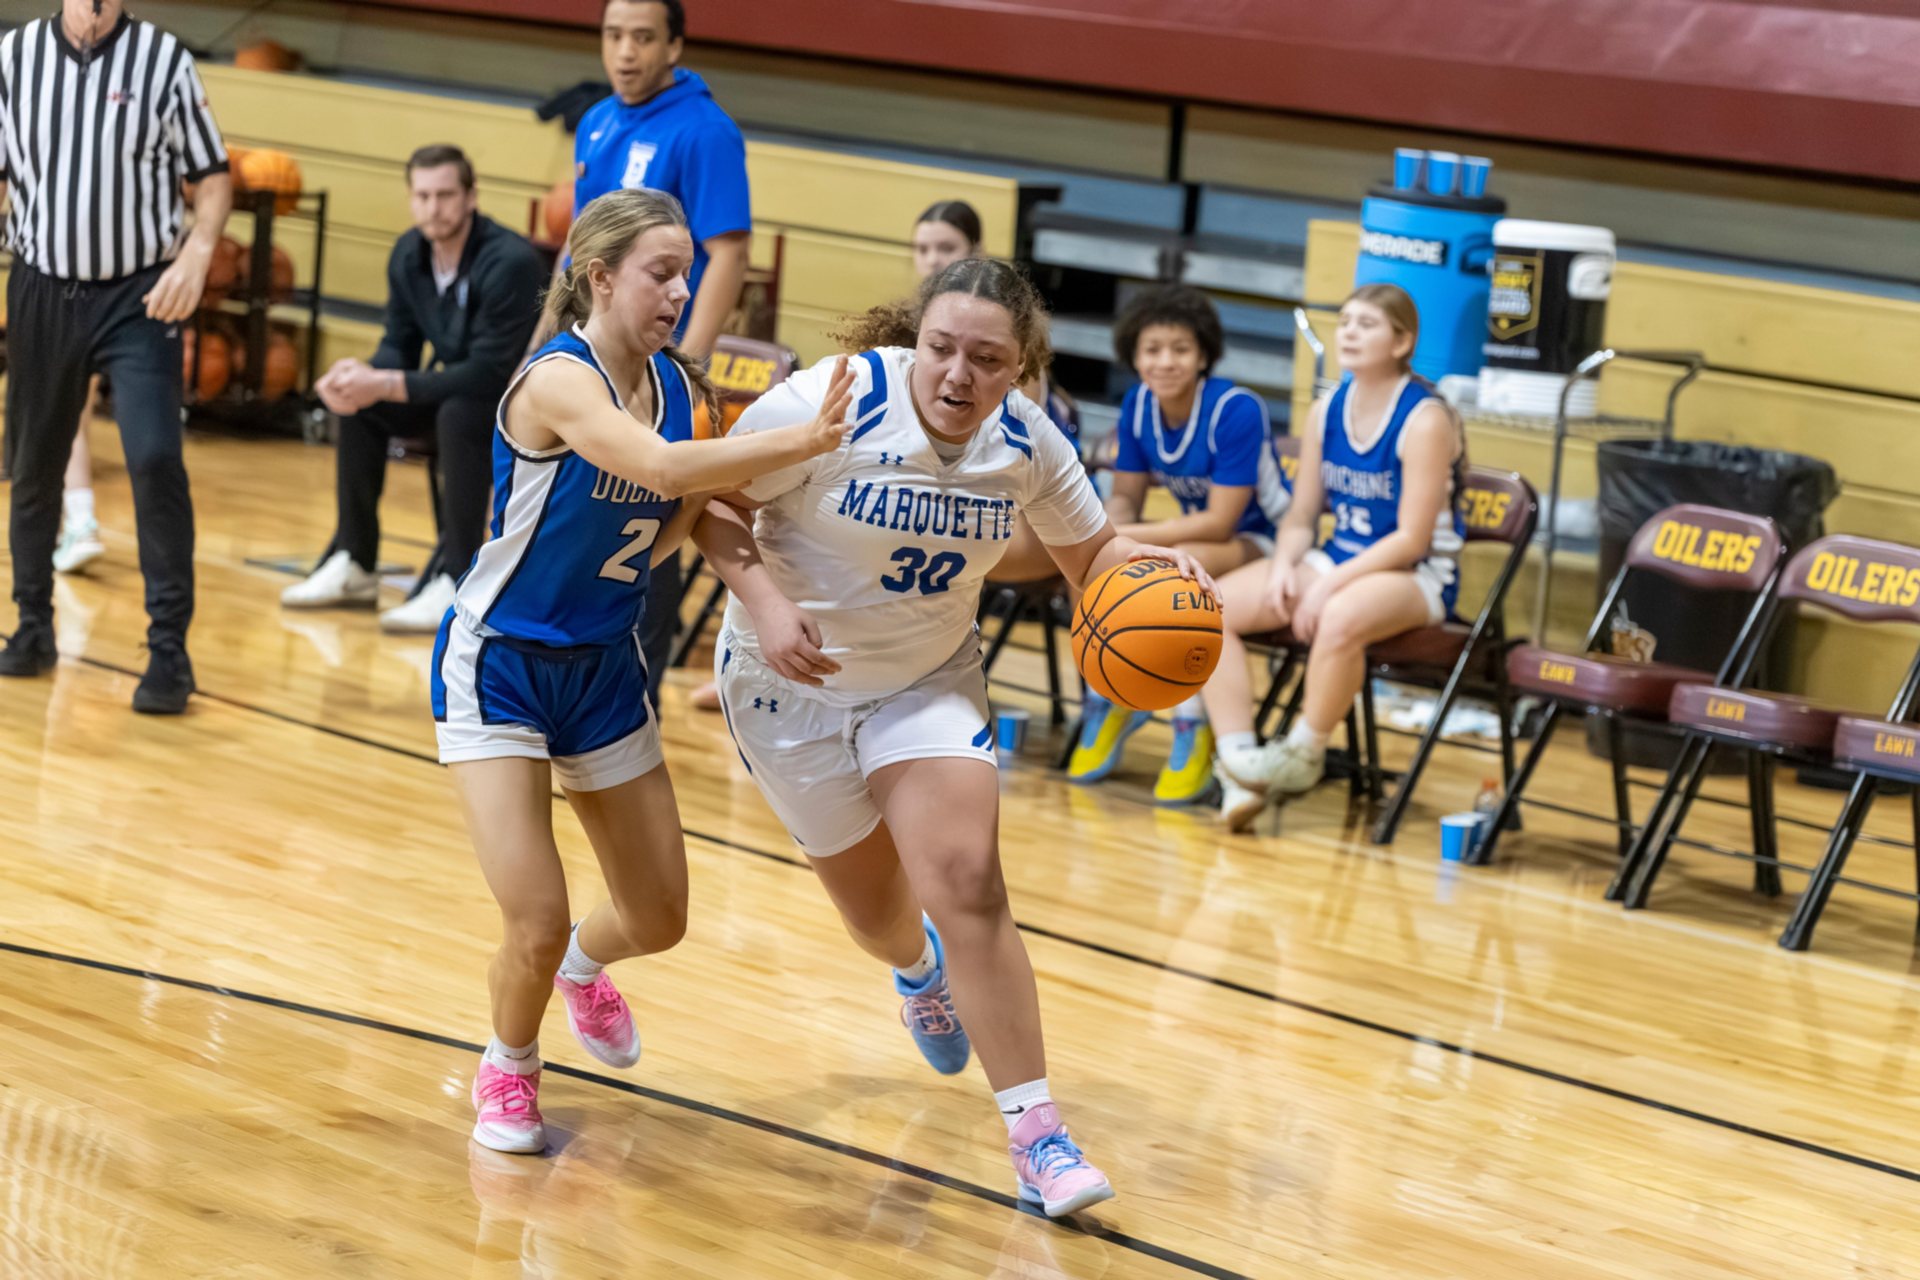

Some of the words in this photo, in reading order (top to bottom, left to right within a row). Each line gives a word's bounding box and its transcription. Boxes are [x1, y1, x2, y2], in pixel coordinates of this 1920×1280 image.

[837, 479, 1014, 541] MARQUETTE
[597, 517, 661, 584] 2
[880, 546, 967, 596] 30
[1653, 519, 1761, 574] OILERS
[1806, 552, 1920, 608] OILERS
